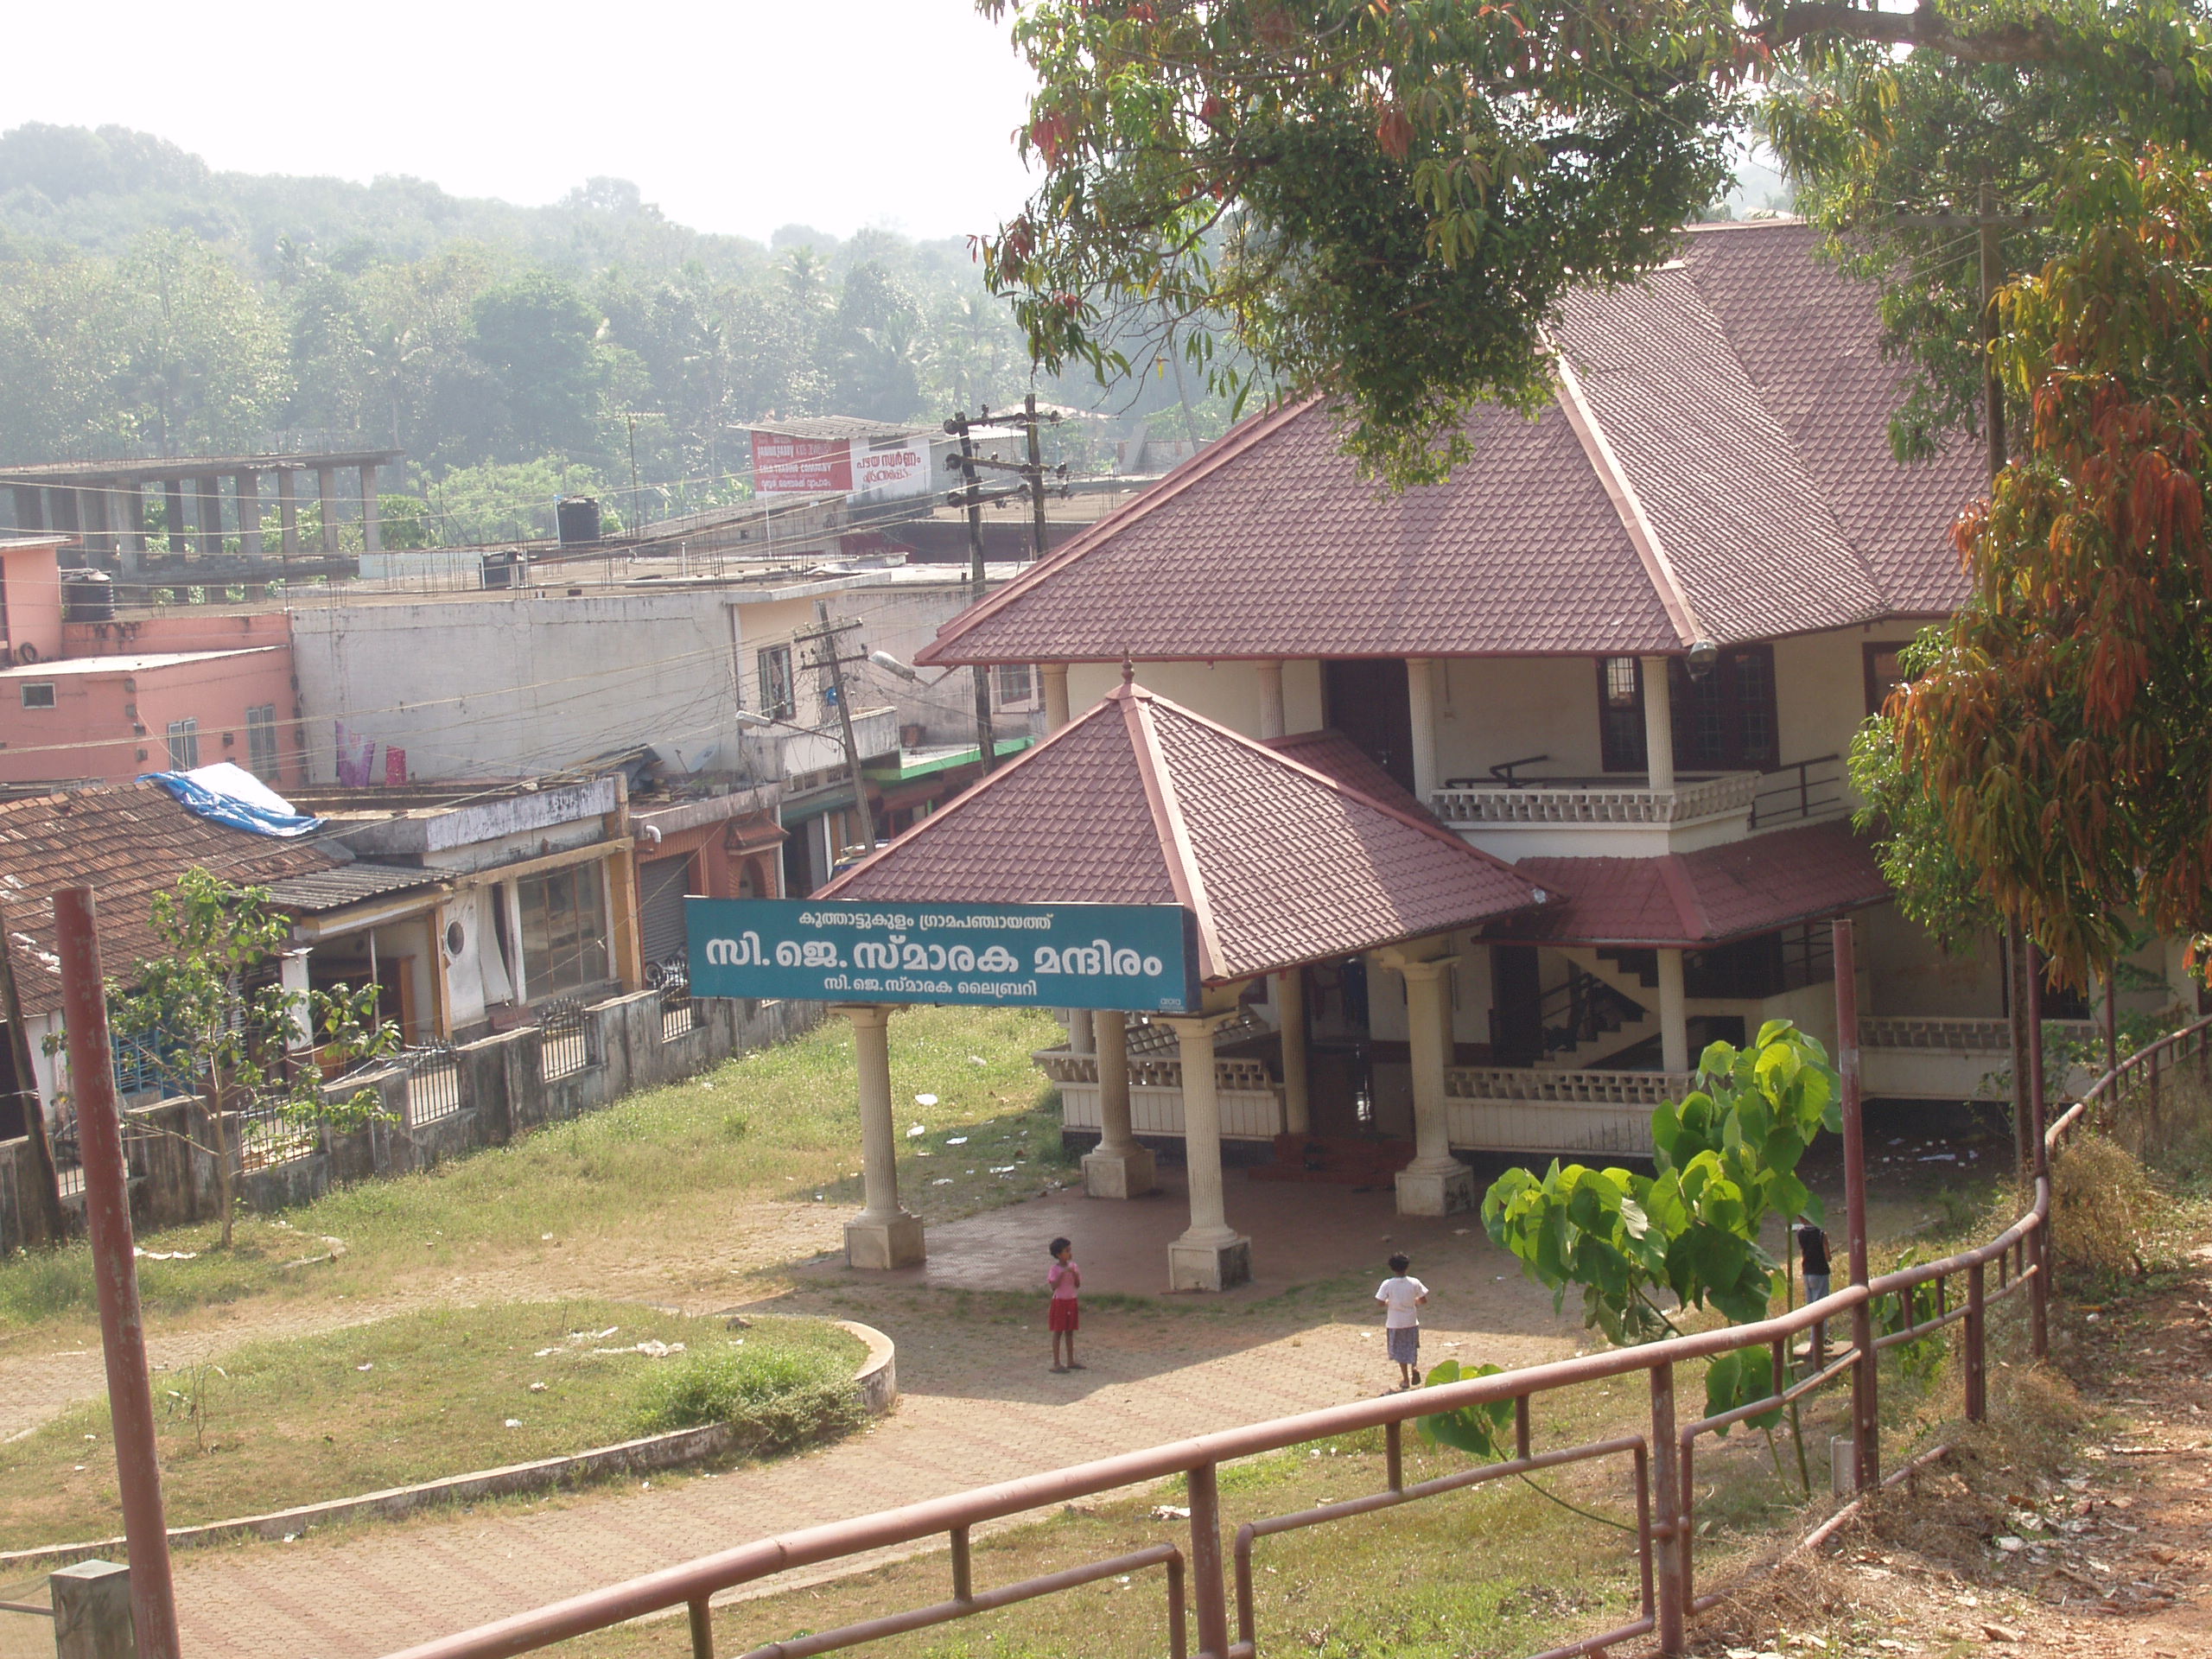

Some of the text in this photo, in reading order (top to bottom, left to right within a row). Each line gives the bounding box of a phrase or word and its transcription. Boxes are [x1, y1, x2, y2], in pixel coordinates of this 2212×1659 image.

[798, 912, 1054, 931] കൂത്താട്ടുകുളം ഗ്രാമപഞ്ചായത്ത്
[1033, 938, 1163, 976] മന്ദിരം
[957, 979, 1038, 998] ലൈബ്രറി
